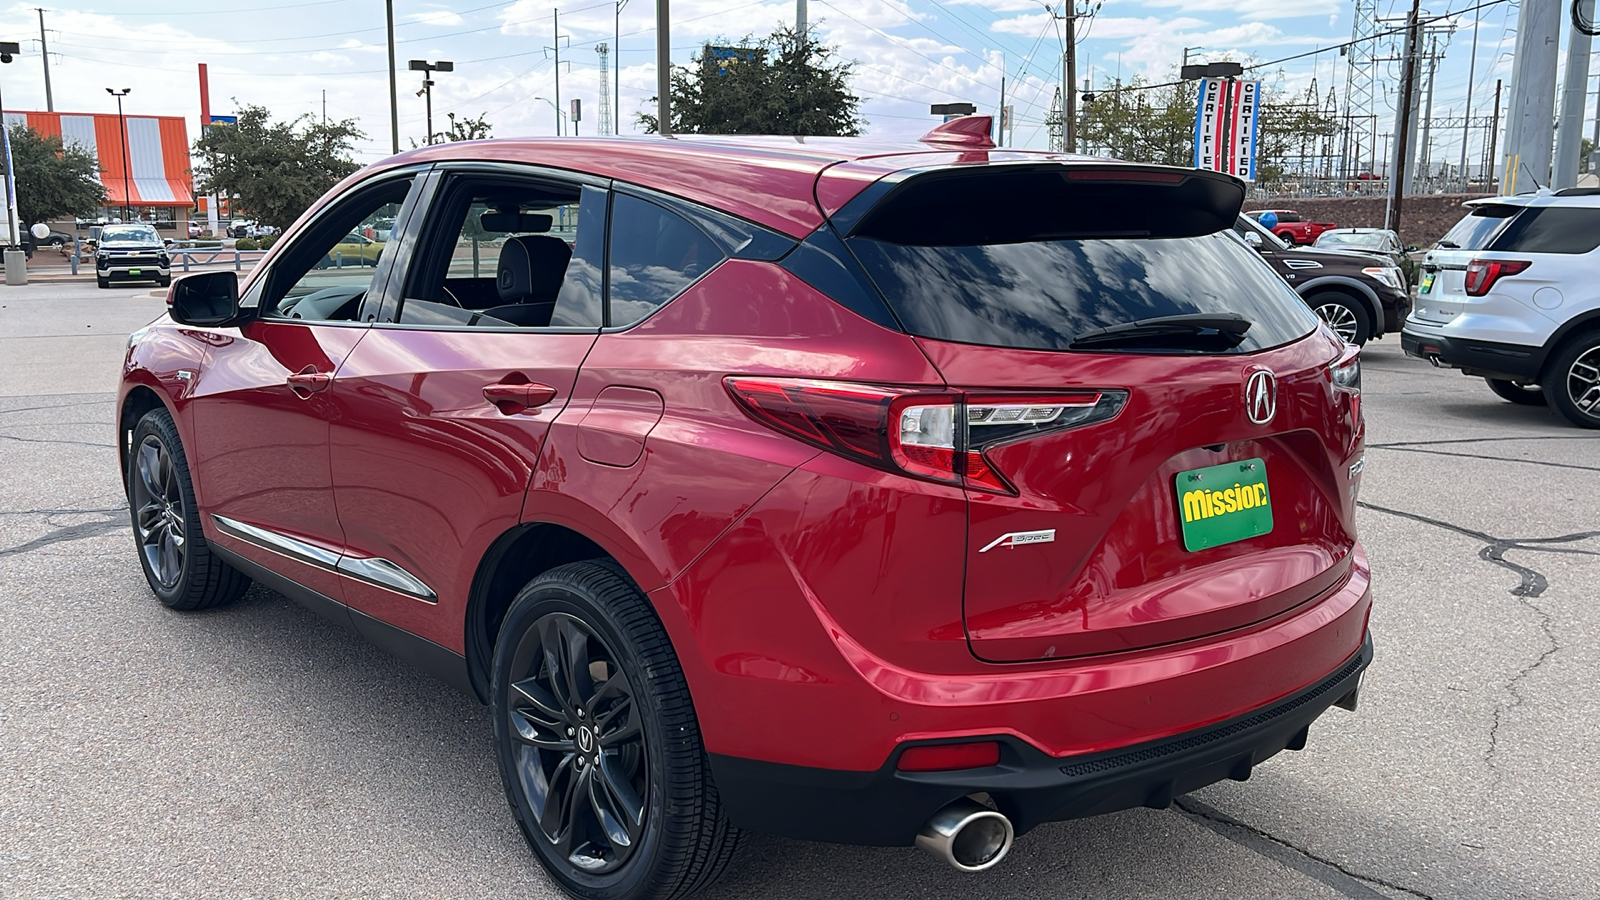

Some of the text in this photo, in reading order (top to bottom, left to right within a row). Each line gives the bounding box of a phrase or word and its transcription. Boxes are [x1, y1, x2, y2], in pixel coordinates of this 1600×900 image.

[1203, 82, 1218, 171] CERTIFIE
[1239, 84, 1254, 176] CERTIFIED
[1183, 482, 1268, 523] Mission
